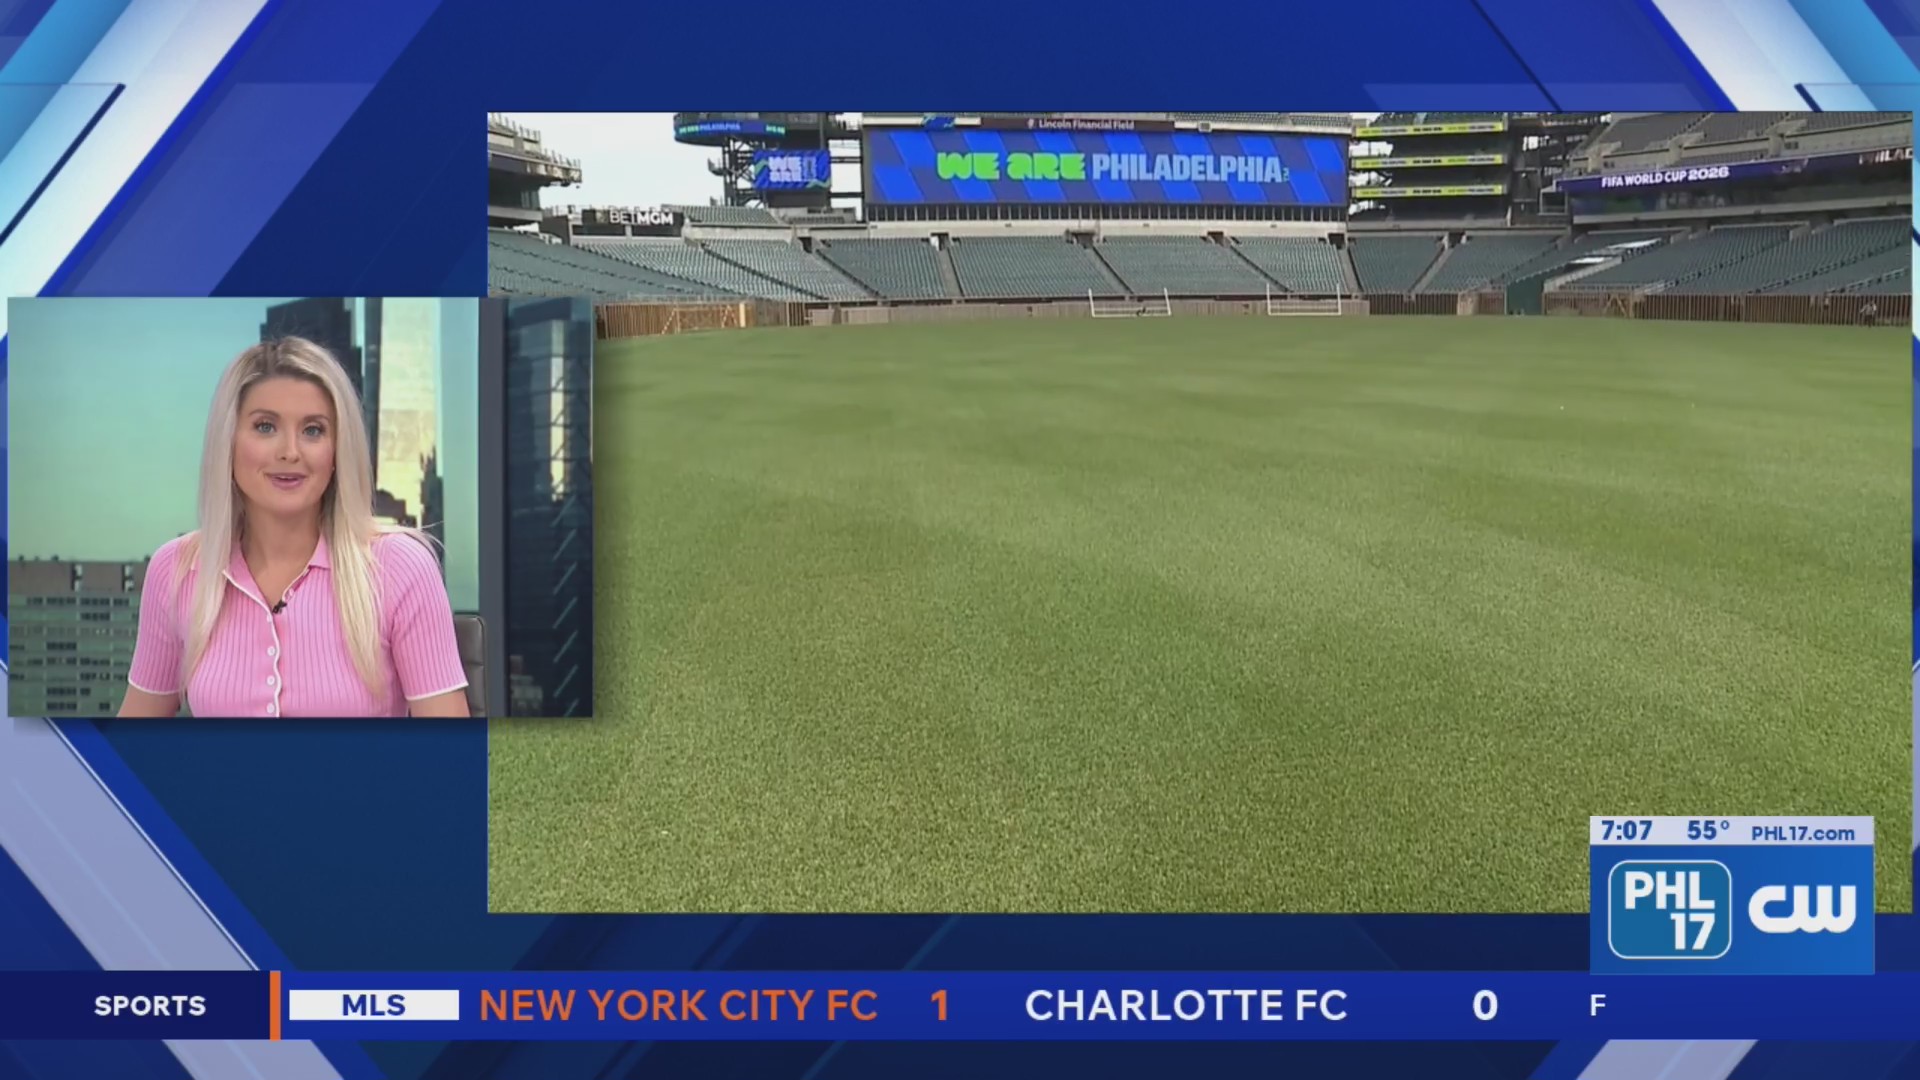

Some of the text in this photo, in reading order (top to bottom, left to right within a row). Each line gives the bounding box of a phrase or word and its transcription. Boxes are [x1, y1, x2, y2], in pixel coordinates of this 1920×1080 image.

[1038, 119, 1135, 130] Lincoln Financial Field
[937, 152, 1000, 180] WE
[1092, 153, 1283, 183] PHILADELPHIA
[1601, 166, 1730, 188] FIFA WORLD CUP 2026
[609, 210, 674, 225] BETMGM
